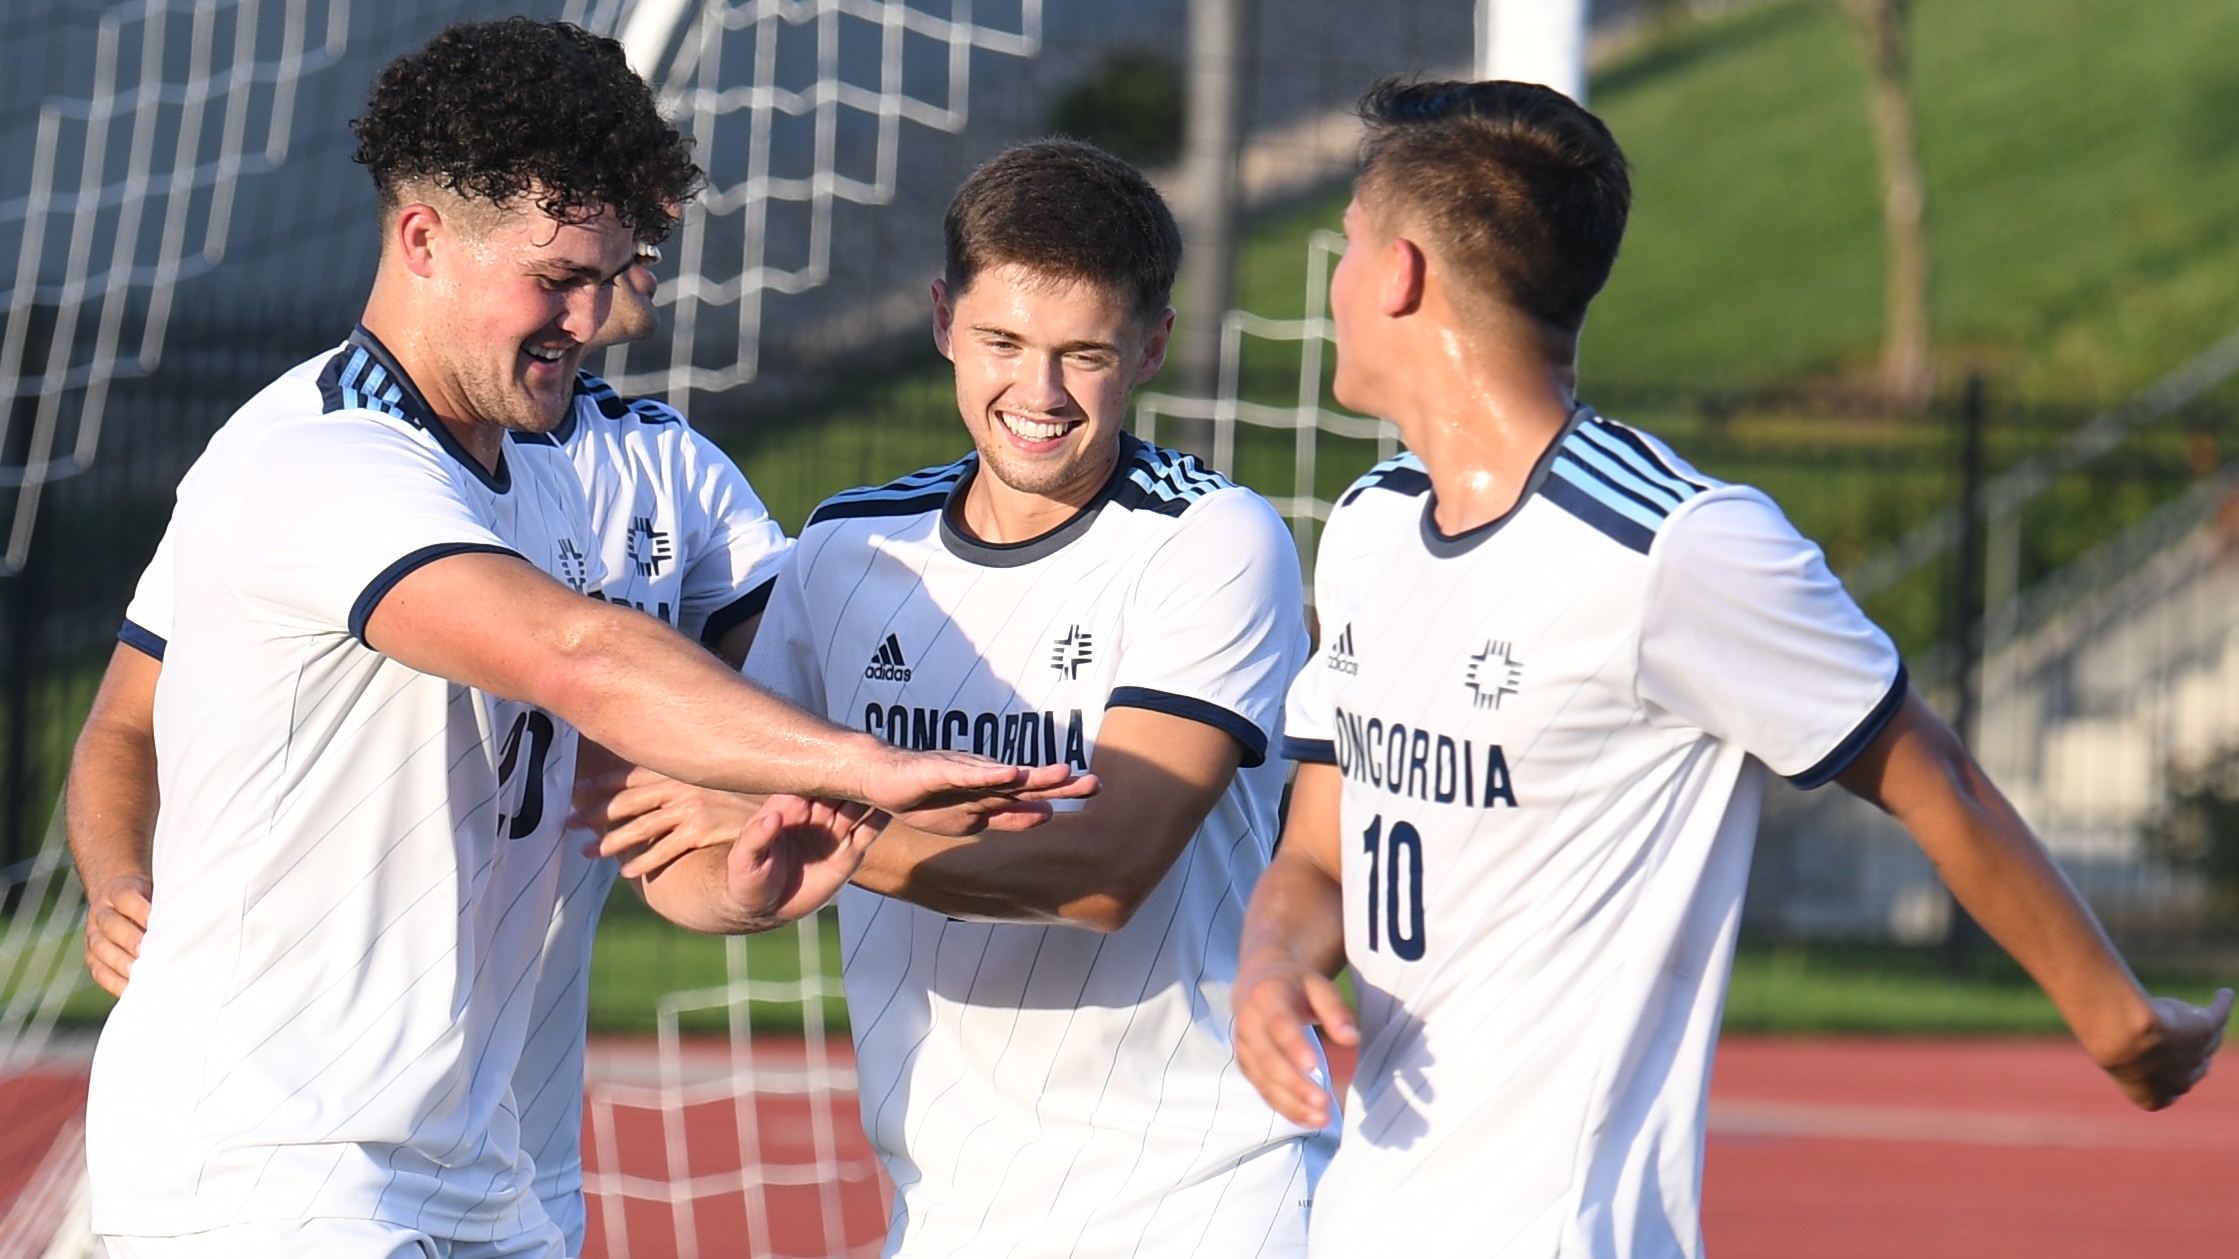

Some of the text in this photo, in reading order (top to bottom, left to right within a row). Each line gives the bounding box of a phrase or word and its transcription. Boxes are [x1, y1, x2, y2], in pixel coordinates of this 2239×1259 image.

[865, 663, 912, 683] adidas
[865, 702, 1088, 770] CONCORDIA
[1362, 813, 1426, 962] 10
